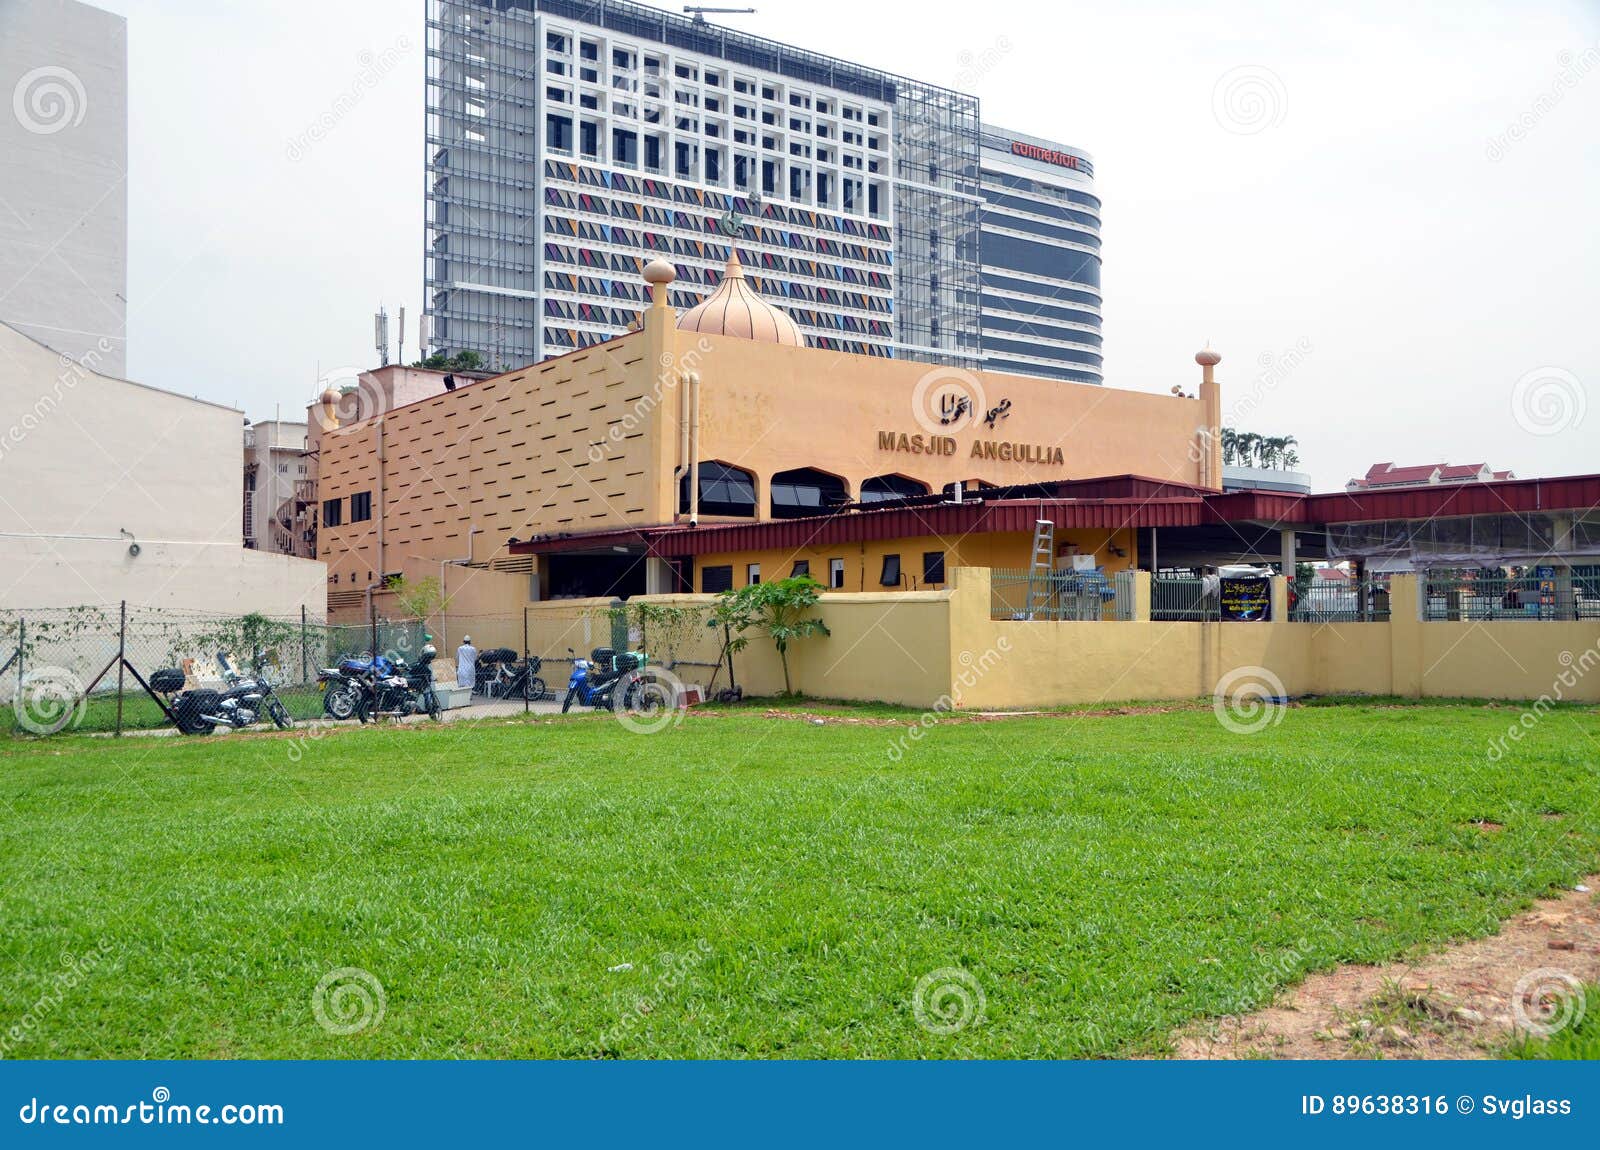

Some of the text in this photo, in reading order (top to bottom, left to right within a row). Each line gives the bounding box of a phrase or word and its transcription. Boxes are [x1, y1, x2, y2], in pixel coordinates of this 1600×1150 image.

[1012, 141, 1079, 169] connexion
[878, 430, 1065, 465] MASJID ANGULLIA
